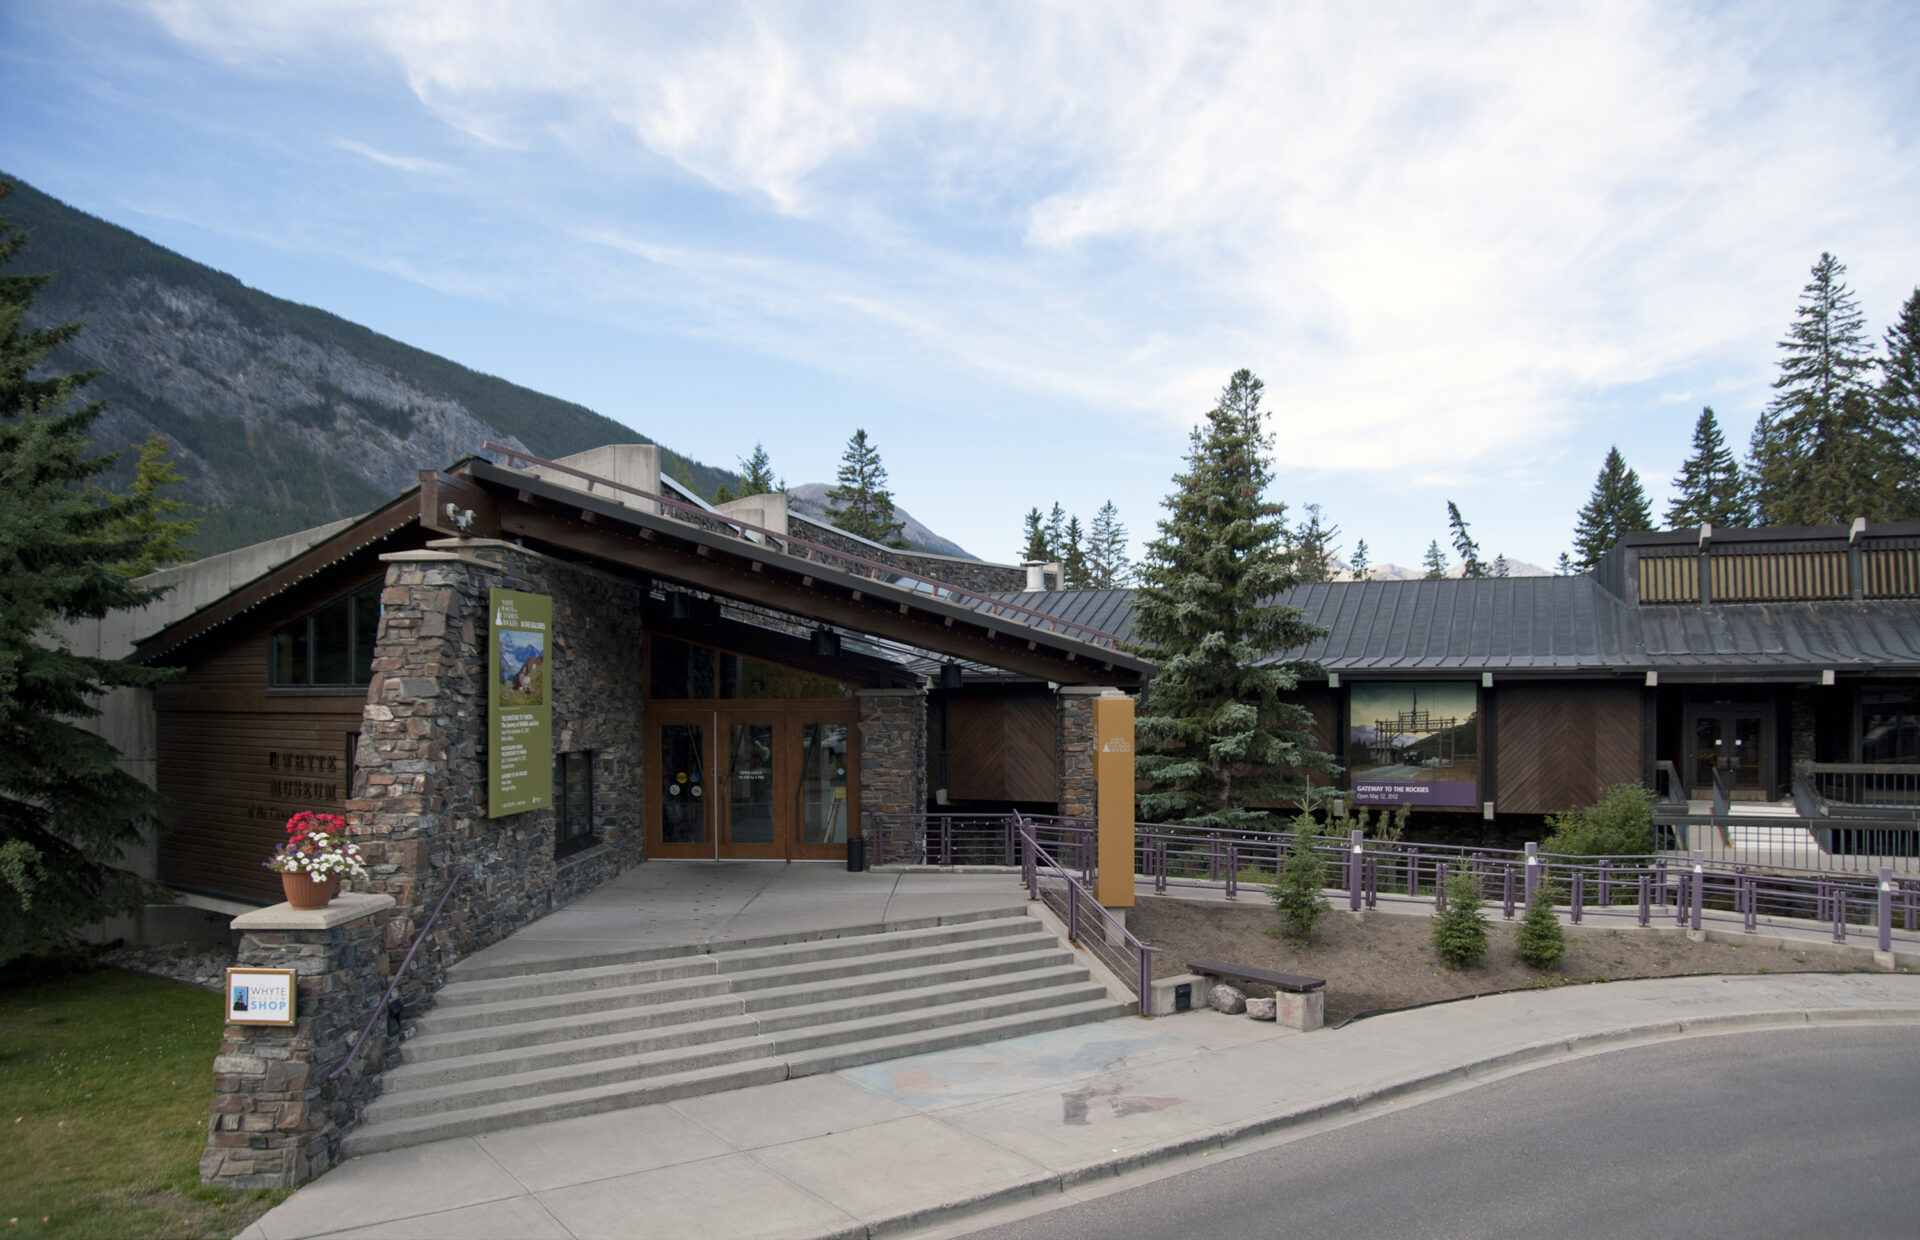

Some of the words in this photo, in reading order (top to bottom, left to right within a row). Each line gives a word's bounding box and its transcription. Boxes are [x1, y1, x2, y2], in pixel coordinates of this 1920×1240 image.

[283, 753, 336, 772] WHYTE
[271, 780, 336, 801] MUSEUM
[251, 987, 286, 996] WHYTE
[251, 1001, 286, 1010] SHOP
